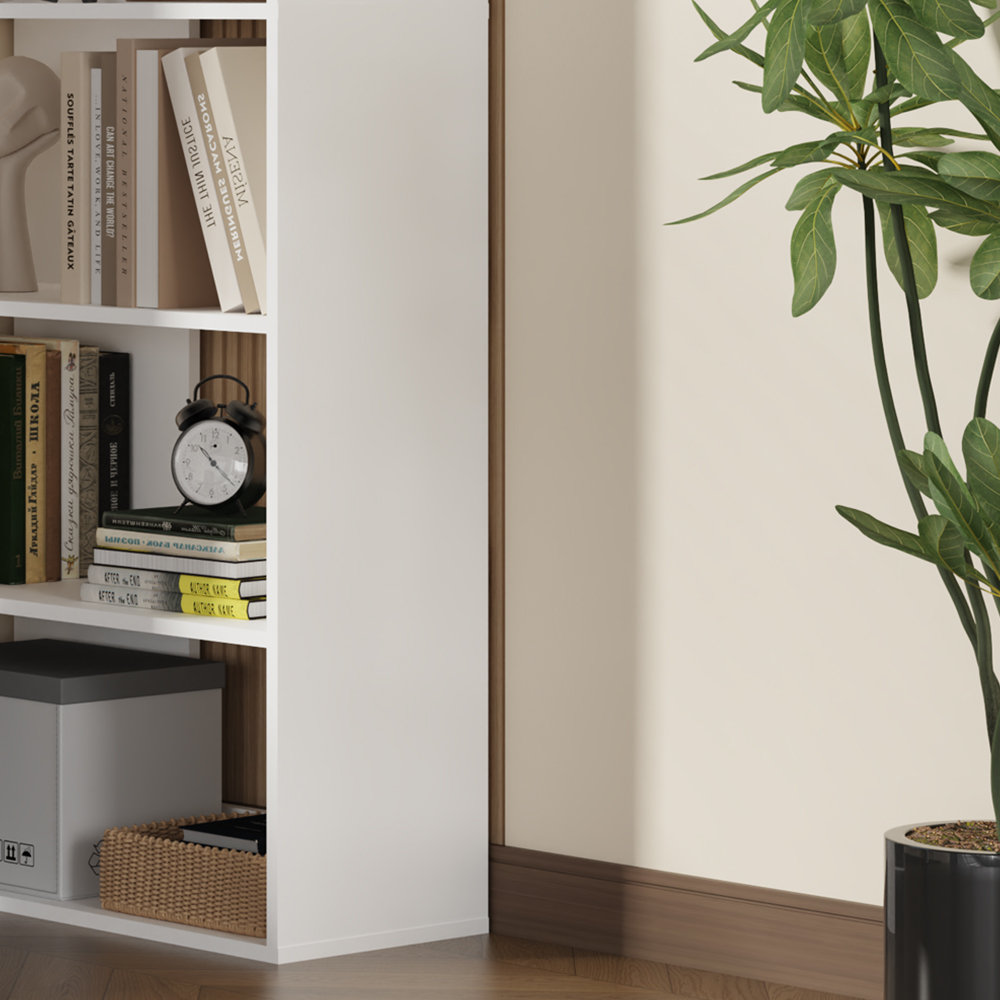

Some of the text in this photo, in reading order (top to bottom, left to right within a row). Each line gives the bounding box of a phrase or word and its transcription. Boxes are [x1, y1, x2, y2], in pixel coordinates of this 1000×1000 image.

[67, 93, 75, 145] SOUFFLÉS
[106, 126, 115, 238] CAN ART CHANGE THE WORLD?
[67, 220, 76, 270] GÂTEAUX
[29, 381, 40, 442] ШКОЛА
[212, 429, 219, 439] 12
[109, 442, 118, 478] ЧЕРНОЕ
[110, 479, 118, 487] И
[64, 500, 78, 552] Сказки
[104, 572, 119, 584] AFTER
[129, 575, 140, 587] END
[190, 582, 227, 597] AUTHOR NAME
[98, 590, 115, 602] AFTER
[126, 593, 138, 606] END
[193, 601, 235, 617] AUTHOR NAME
